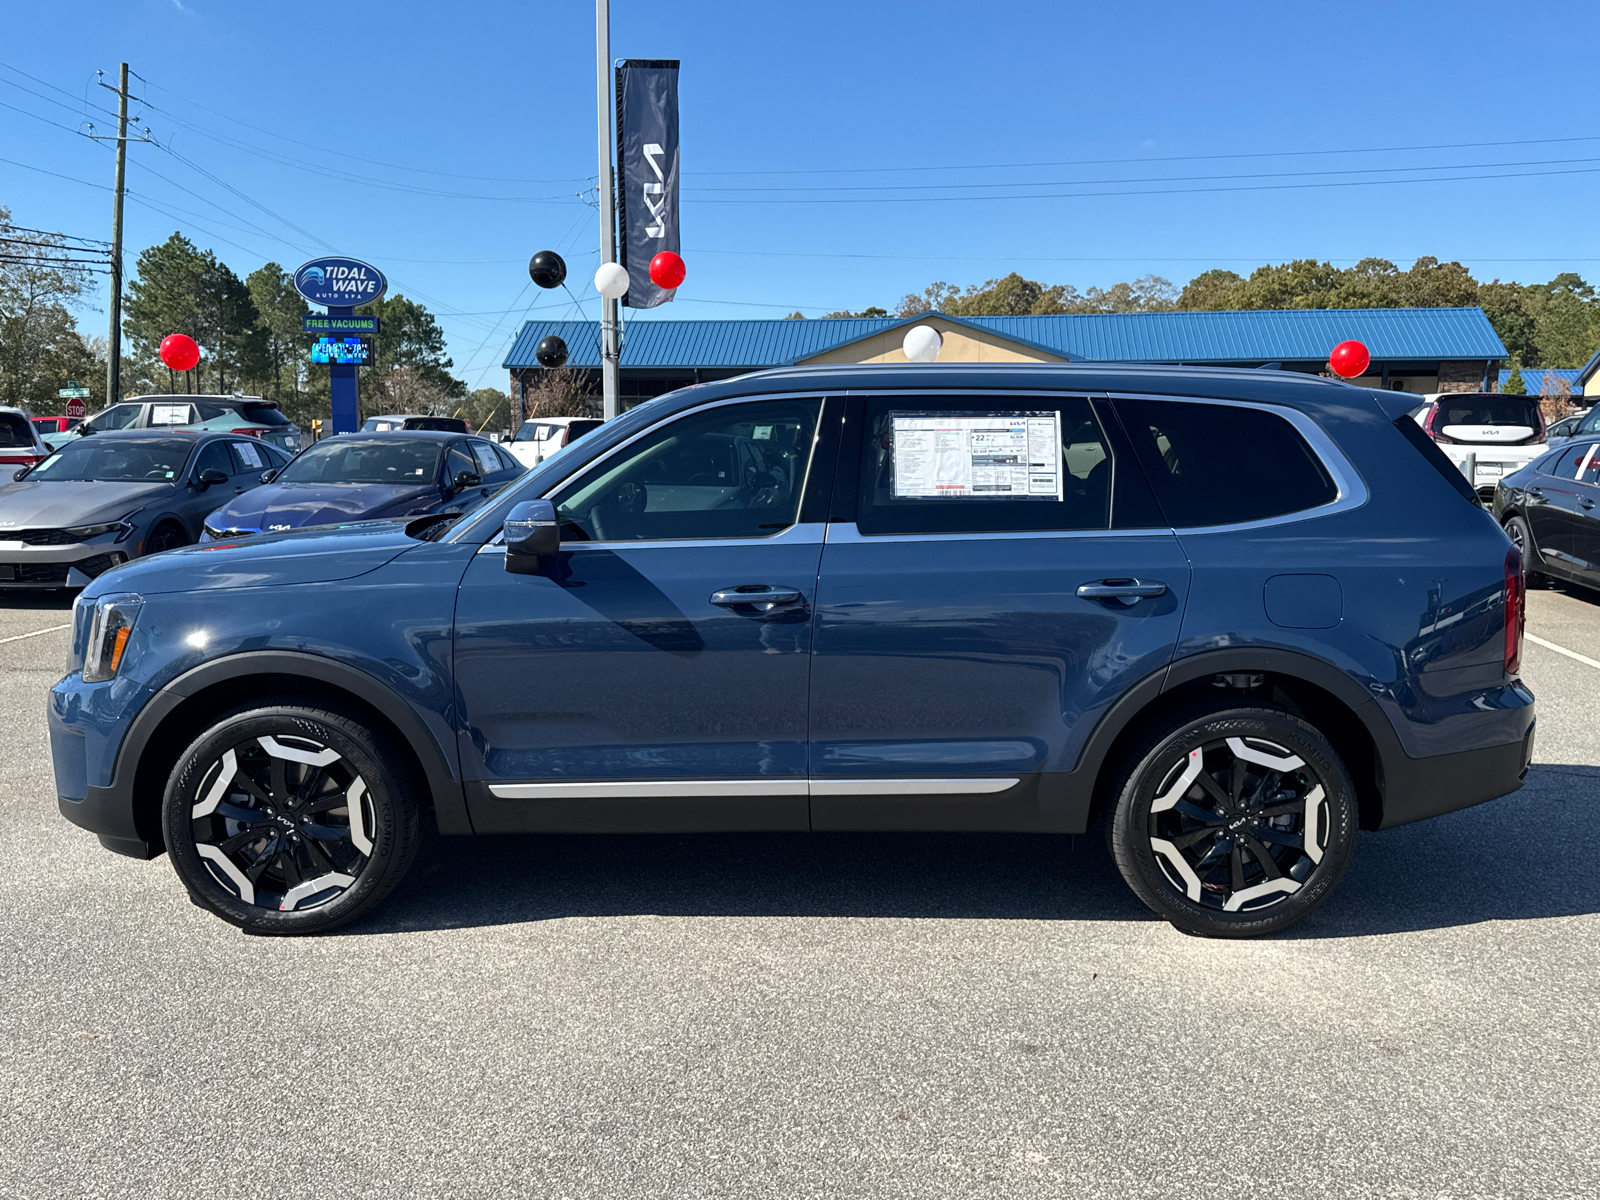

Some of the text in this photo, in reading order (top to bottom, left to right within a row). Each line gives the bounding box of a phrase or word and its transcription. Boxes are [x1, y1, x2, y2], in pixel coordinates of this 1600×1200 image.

[325, 266, 367, 279] TIDAL
[332, 280, 376, 293] WAVE
[306, 319, 374, 329] FREE VACUUMS
[67, 405, 85, 415] STOP
[1288, 731, 1331, 772] KUMHO
[380, 802, 391, 858] KUMHO
